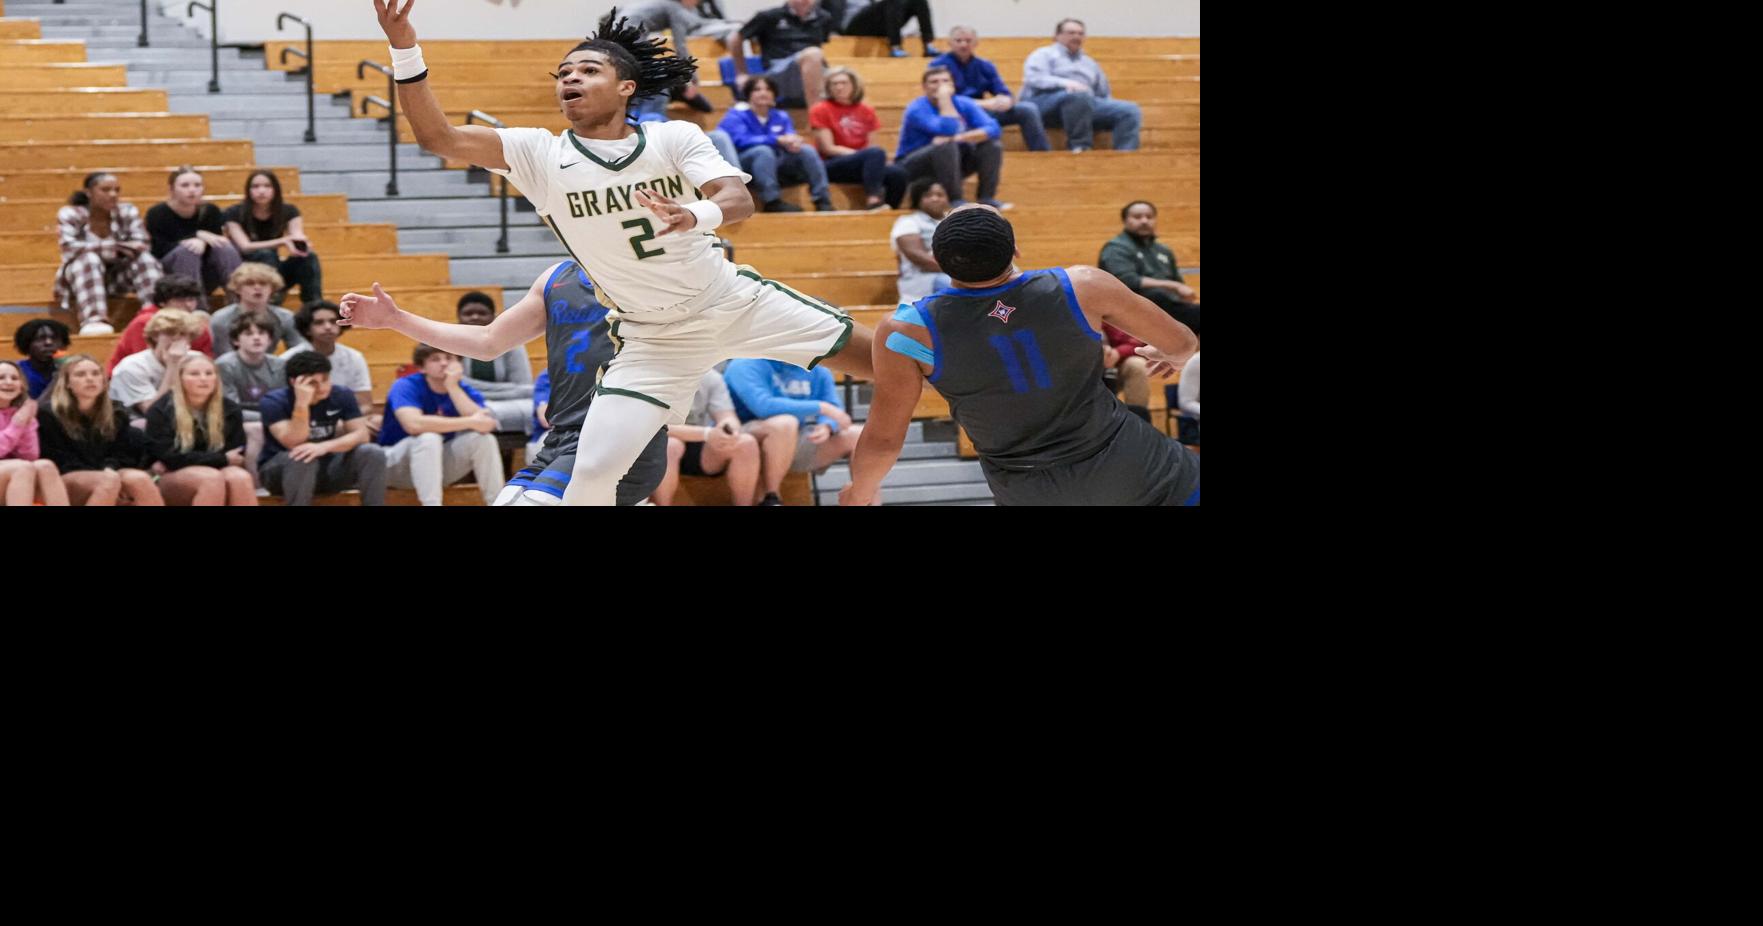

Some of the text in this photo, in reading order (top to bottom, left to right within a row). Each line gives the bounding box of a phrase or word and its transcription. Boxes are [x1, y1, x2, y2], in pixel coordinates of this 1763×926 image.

[621, 217, 666, 260] 2
[566, 329, 592, 374] 2
[988, 329, 1053, 393] 11
